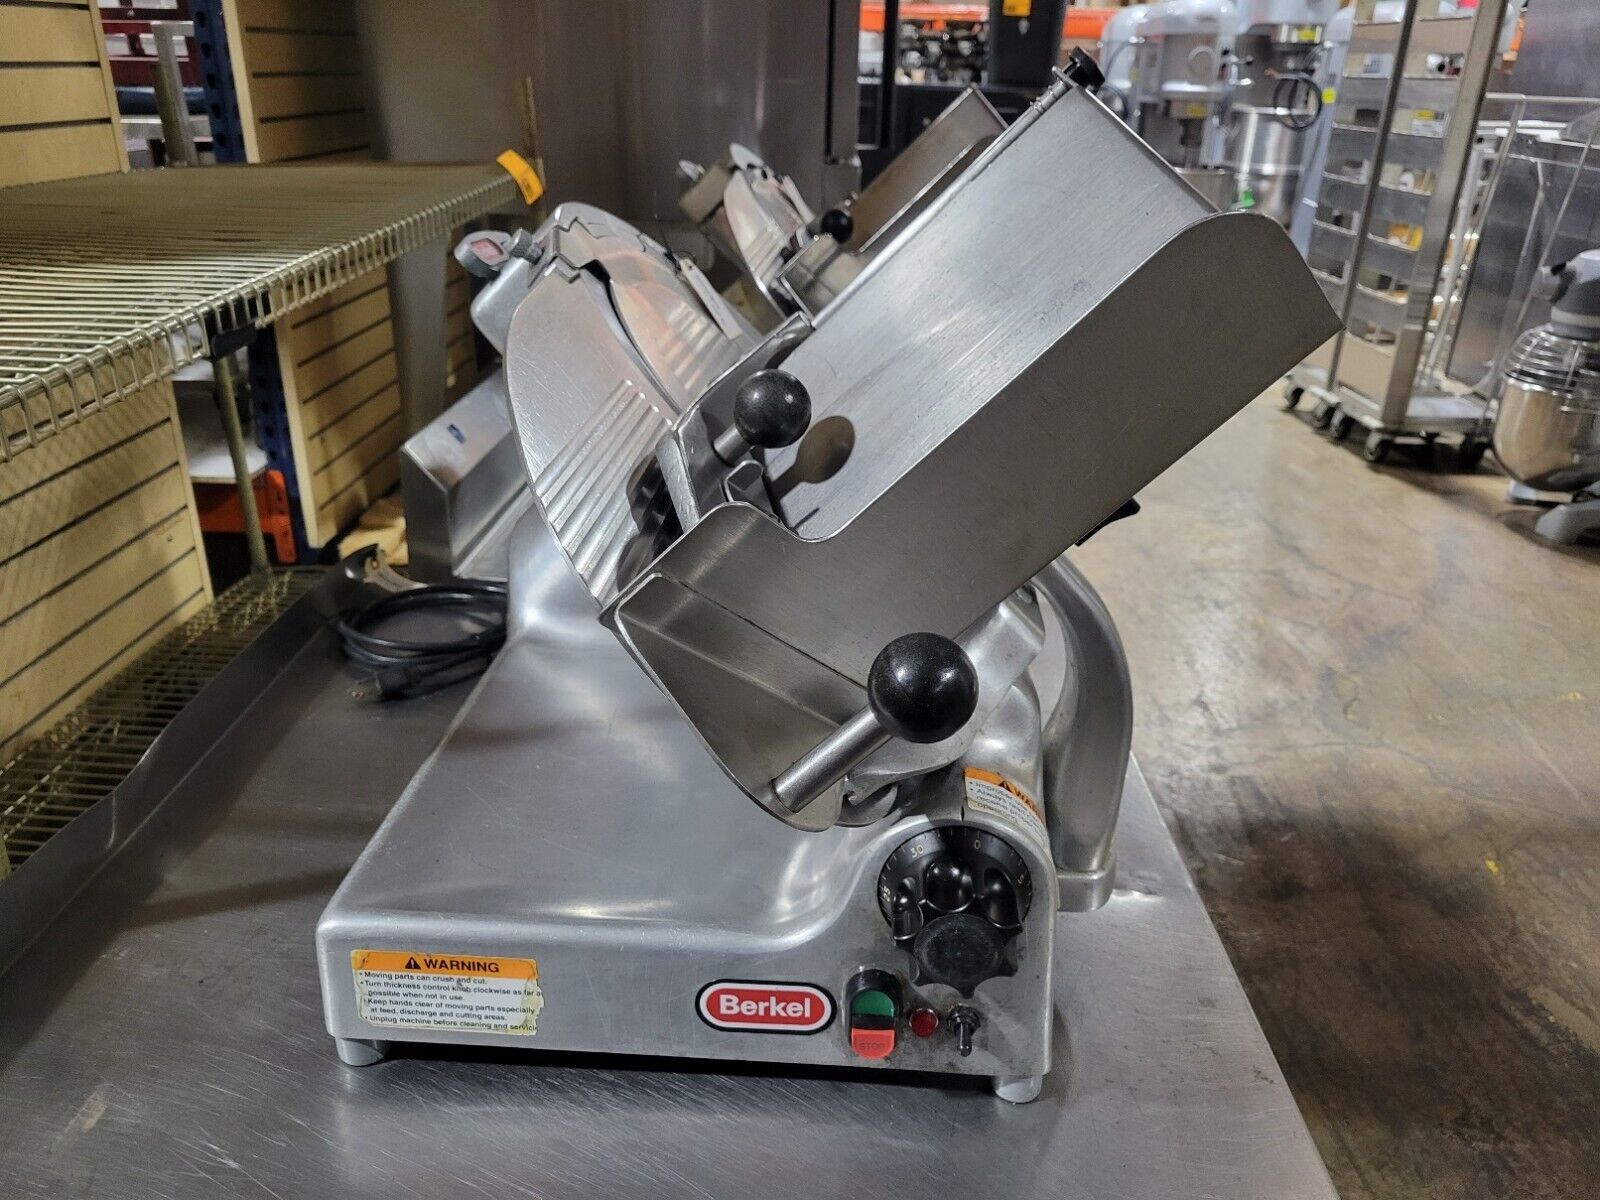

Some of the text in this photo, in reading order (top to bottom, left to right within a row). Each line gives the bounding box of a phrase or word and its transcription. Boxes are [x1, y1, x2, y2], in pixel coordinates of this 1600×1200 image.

[974, 839, 981, 849] 0
[910, 846, 924, 858] 30
[424, 958, 500, 973] WARNING
[364, 971, 393, 980] Moving
[394, 973, 415, 981] parts
[432, 975, 455, 983] crush
[457, 976, 471, 984] and
[368, 989, 401, 997] possible
[402, 991, 424, 999] when
[424, 992, 438, 1000] not
[383, 981, 421, 989] thickness
[422, 983, 451, 991] control
[452, 985, 471, 993] knob
[473, 986, 511, 995] clockwise
[367, 998, 388, 1006] Keep
[389, 999, 413, 1007] hands
[414, 1000, 433, 1008] clear
[445, 1002, 473, 1011] moving
[475, 1004, 495, 1012] parts
[496, 1006, 535, 1015] especially
[719, 993, 811, 1018] Berkel
[379, 1007, 399, 1015] feed,
[399, 1008, 437, 1017] discharge
[455, 1012, 482, 1020] cutting
[369, 1015, 398, 1024] Unplug
[399, 1016, 432, 1025] machine
[433, 1018, 458, 1026] before
[459, 1020, 492, 1029] cleaning
[493, 1022, 508, 1030] and
[858, 1041, 887, 1050] STOP
